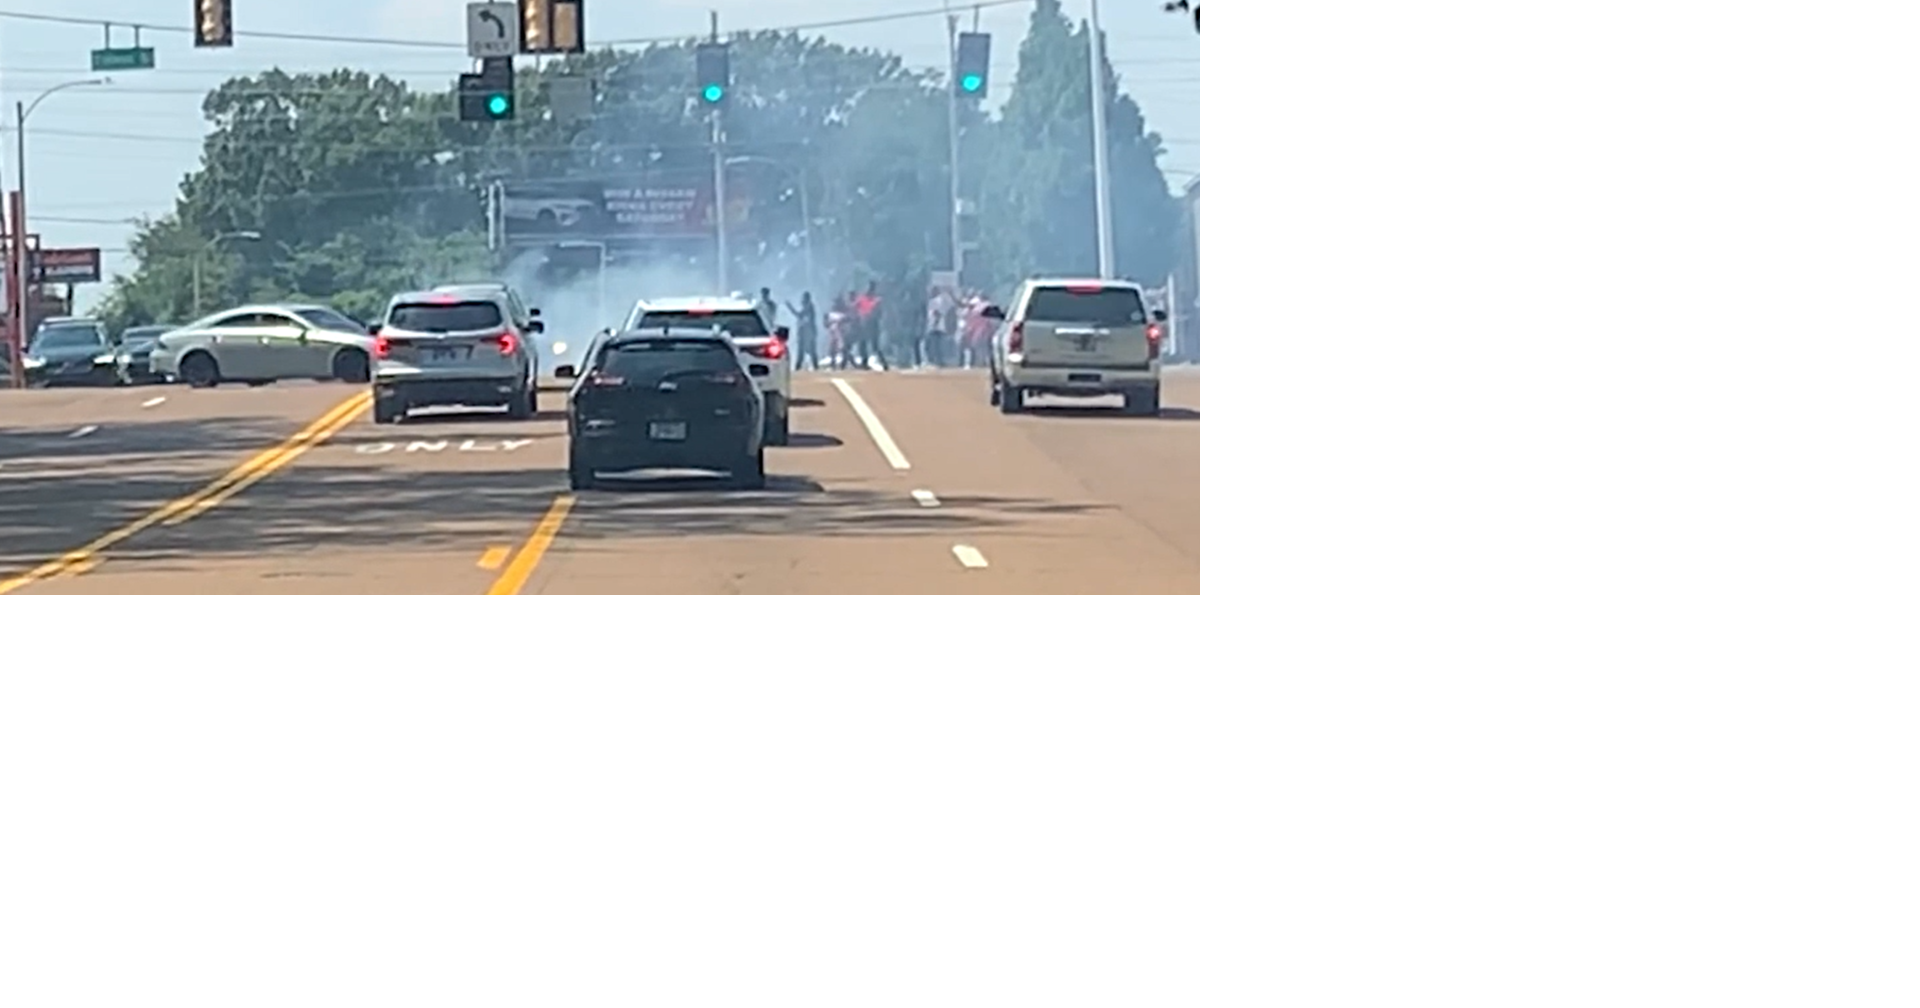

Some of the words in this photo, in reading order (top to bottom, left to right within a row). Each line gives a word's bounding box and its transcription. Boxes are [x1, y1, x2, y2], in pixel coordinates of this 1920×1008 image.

[474, 40, 511, 52] ONLY
[633, 188, 643, 199] A
[355, 438, 535, 454] ONLY
